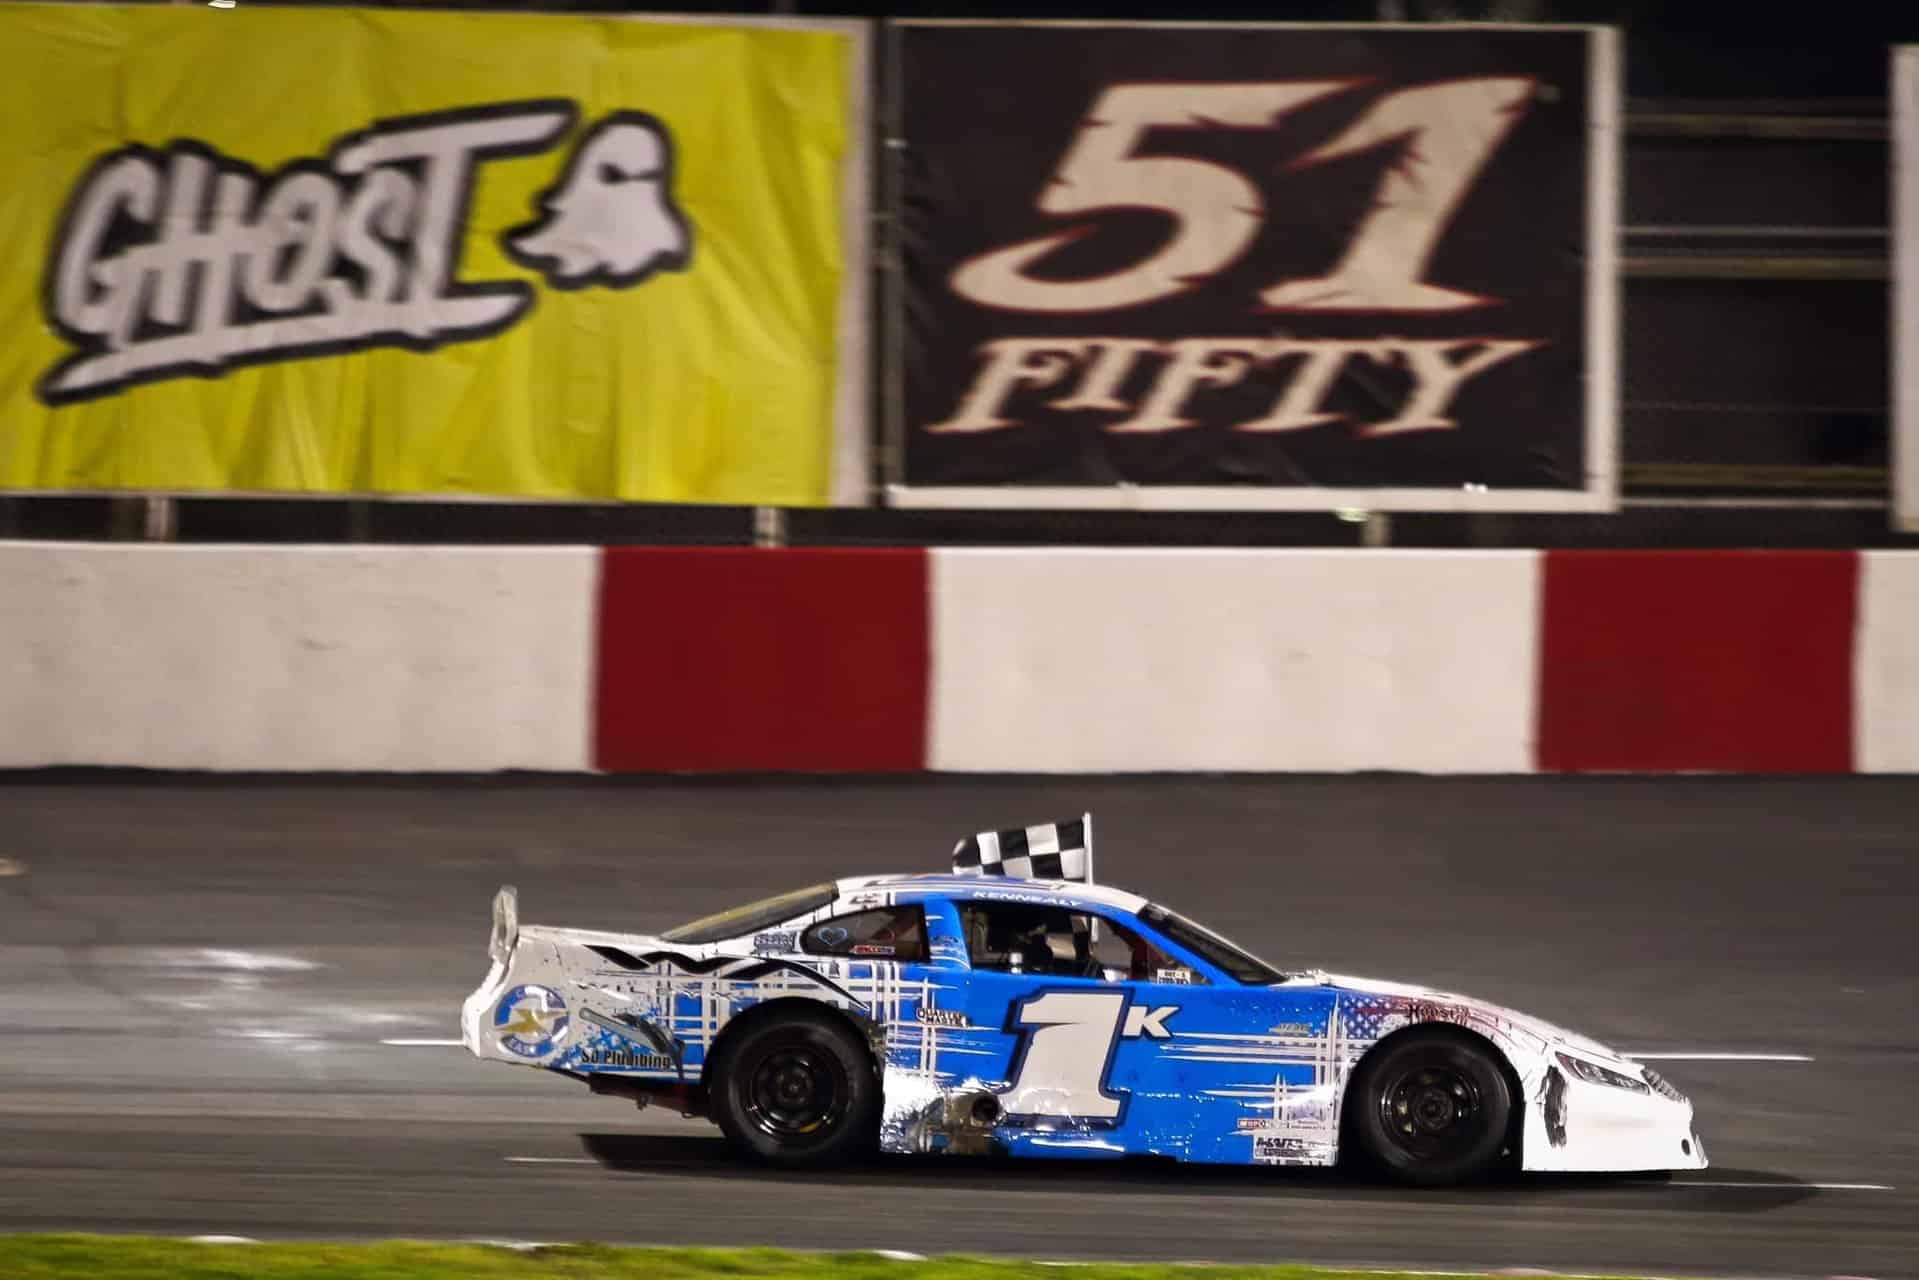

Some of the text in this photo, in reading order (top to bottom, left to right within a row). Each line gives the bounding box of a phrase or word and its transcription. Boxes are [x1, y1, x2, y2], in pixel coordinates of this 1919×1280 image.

[38, 99, 579, 406] GHOST
[948, 76, 1540, 314] 51
[923, 335, 1550, 438] FIFTY
